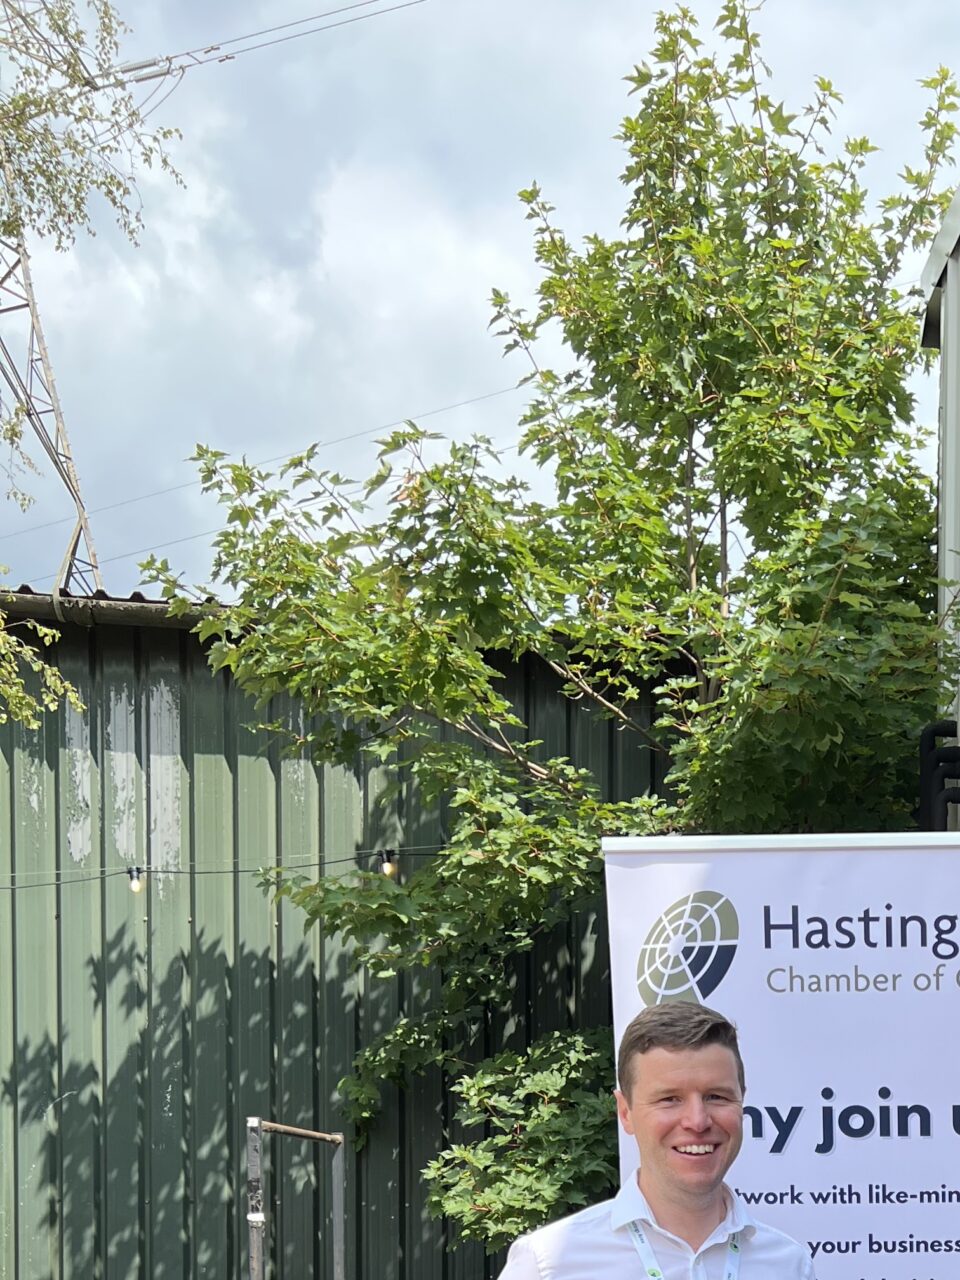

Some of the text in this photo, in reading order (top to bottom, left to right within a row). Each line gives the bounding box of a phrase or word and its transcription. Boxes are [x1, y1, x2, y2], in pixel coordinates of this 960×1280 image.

[766, 964, 903, 993] Chamber
[913, 963, 947, 992] of
[814, 1086, 932, 1154] join
[735, 1184, 804, 1205] work
[809, 1184, 861, 1205] with
[807, 1239, 862, 1260] your
